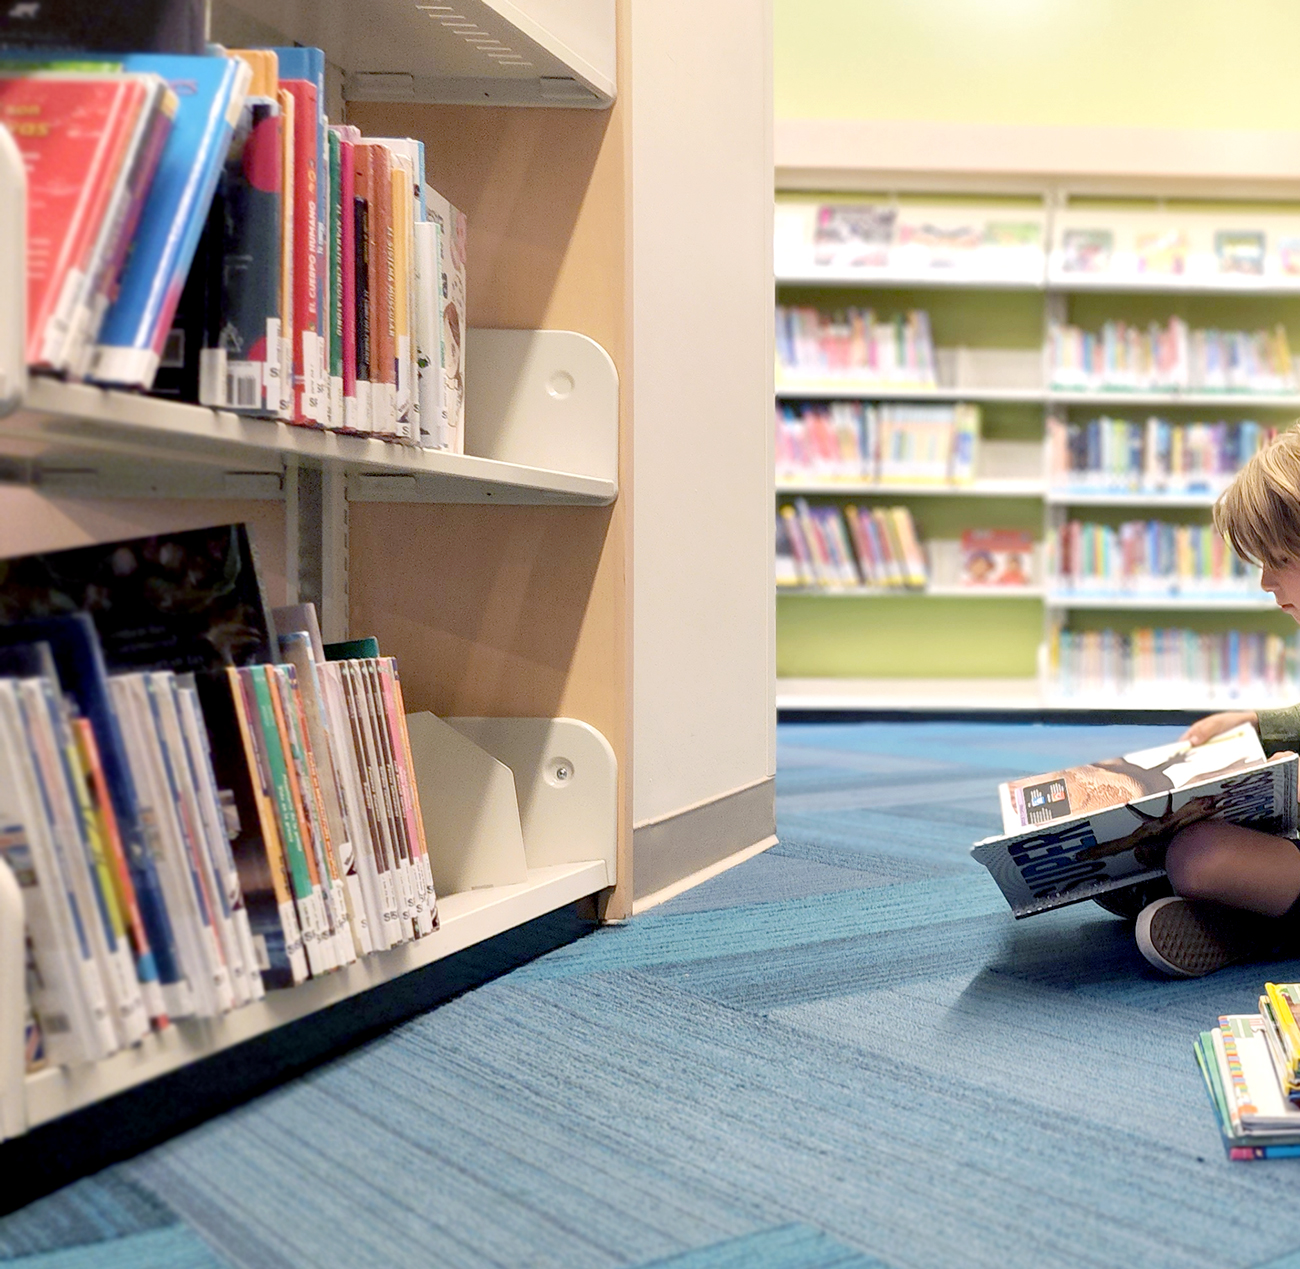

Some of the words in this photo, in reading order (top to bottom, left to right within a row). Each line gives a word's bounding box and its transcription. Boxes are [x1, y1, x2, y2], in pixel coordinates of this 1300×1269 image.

[308, 200, 317, 252] HUMANO
[308, 254, 317, 299] CUERPO
[308, 301, 317, 314] EL
[1007, 820, 1111, 898] SUPER
